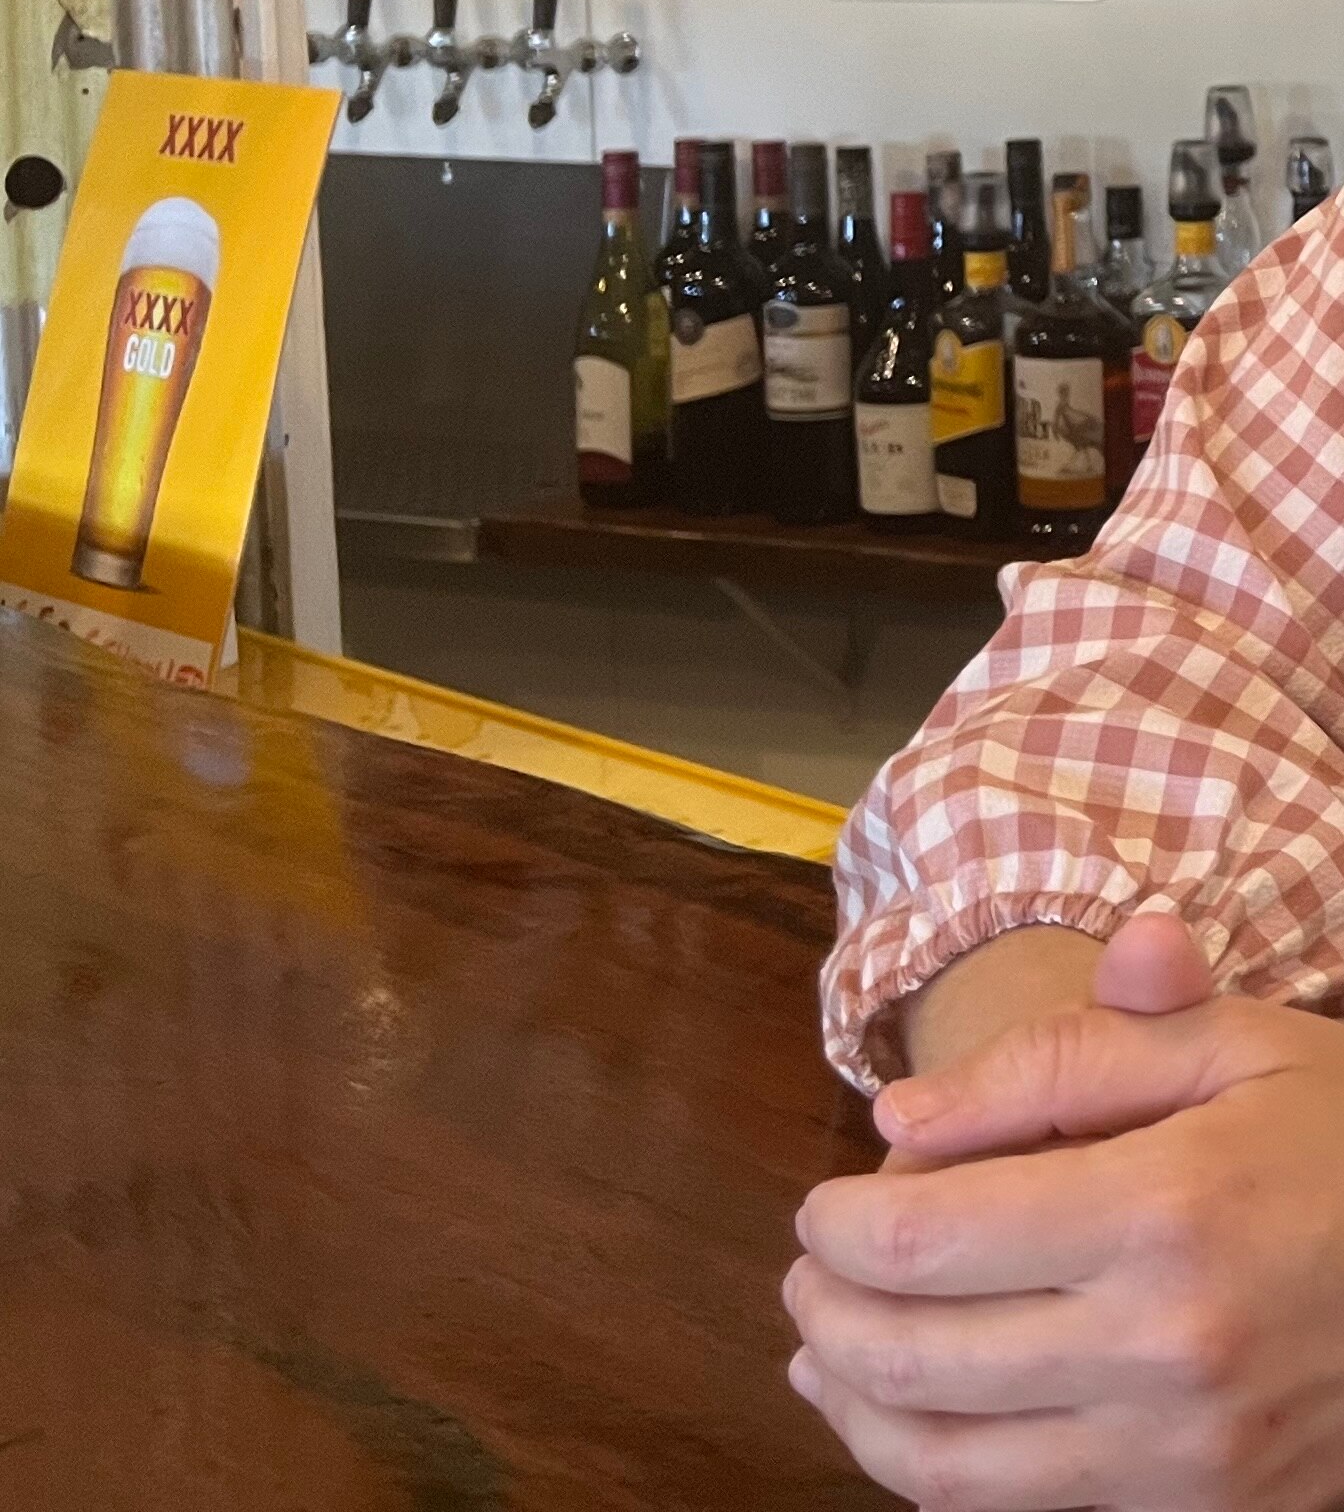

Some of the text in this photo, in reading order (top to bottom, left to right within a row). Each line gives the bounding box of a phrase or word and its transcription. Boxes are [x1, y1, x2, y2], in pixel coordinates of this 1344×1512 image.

[159, 112, 244, 164] XXXX
[124, 290, 196, 336] XXXX
[122, 332, 175, 379] GOLD
